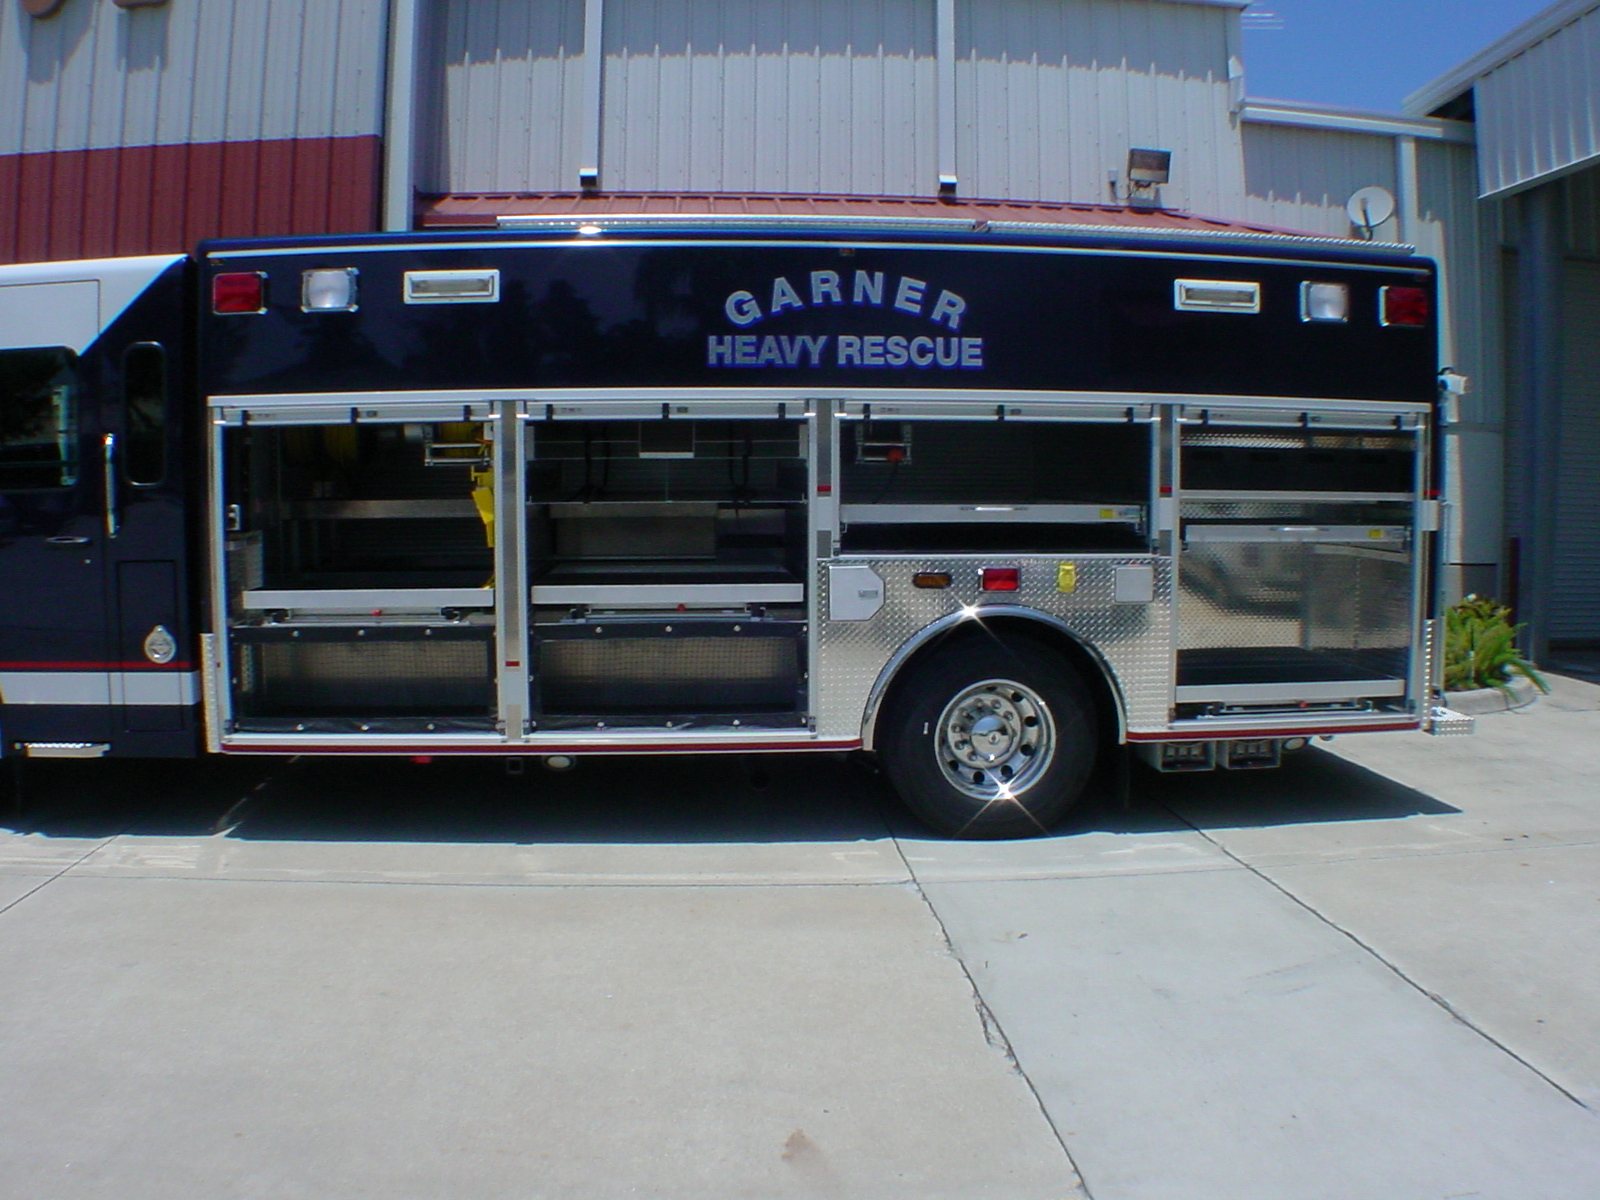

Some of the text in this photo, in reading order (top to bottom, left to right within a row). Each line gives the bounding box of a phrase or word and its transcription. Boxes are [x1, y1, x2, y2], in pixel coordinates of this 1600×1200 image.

[725, 269, 967, 330] GARNER
[707, 335, 984, 368] HEAVY RESCUE
